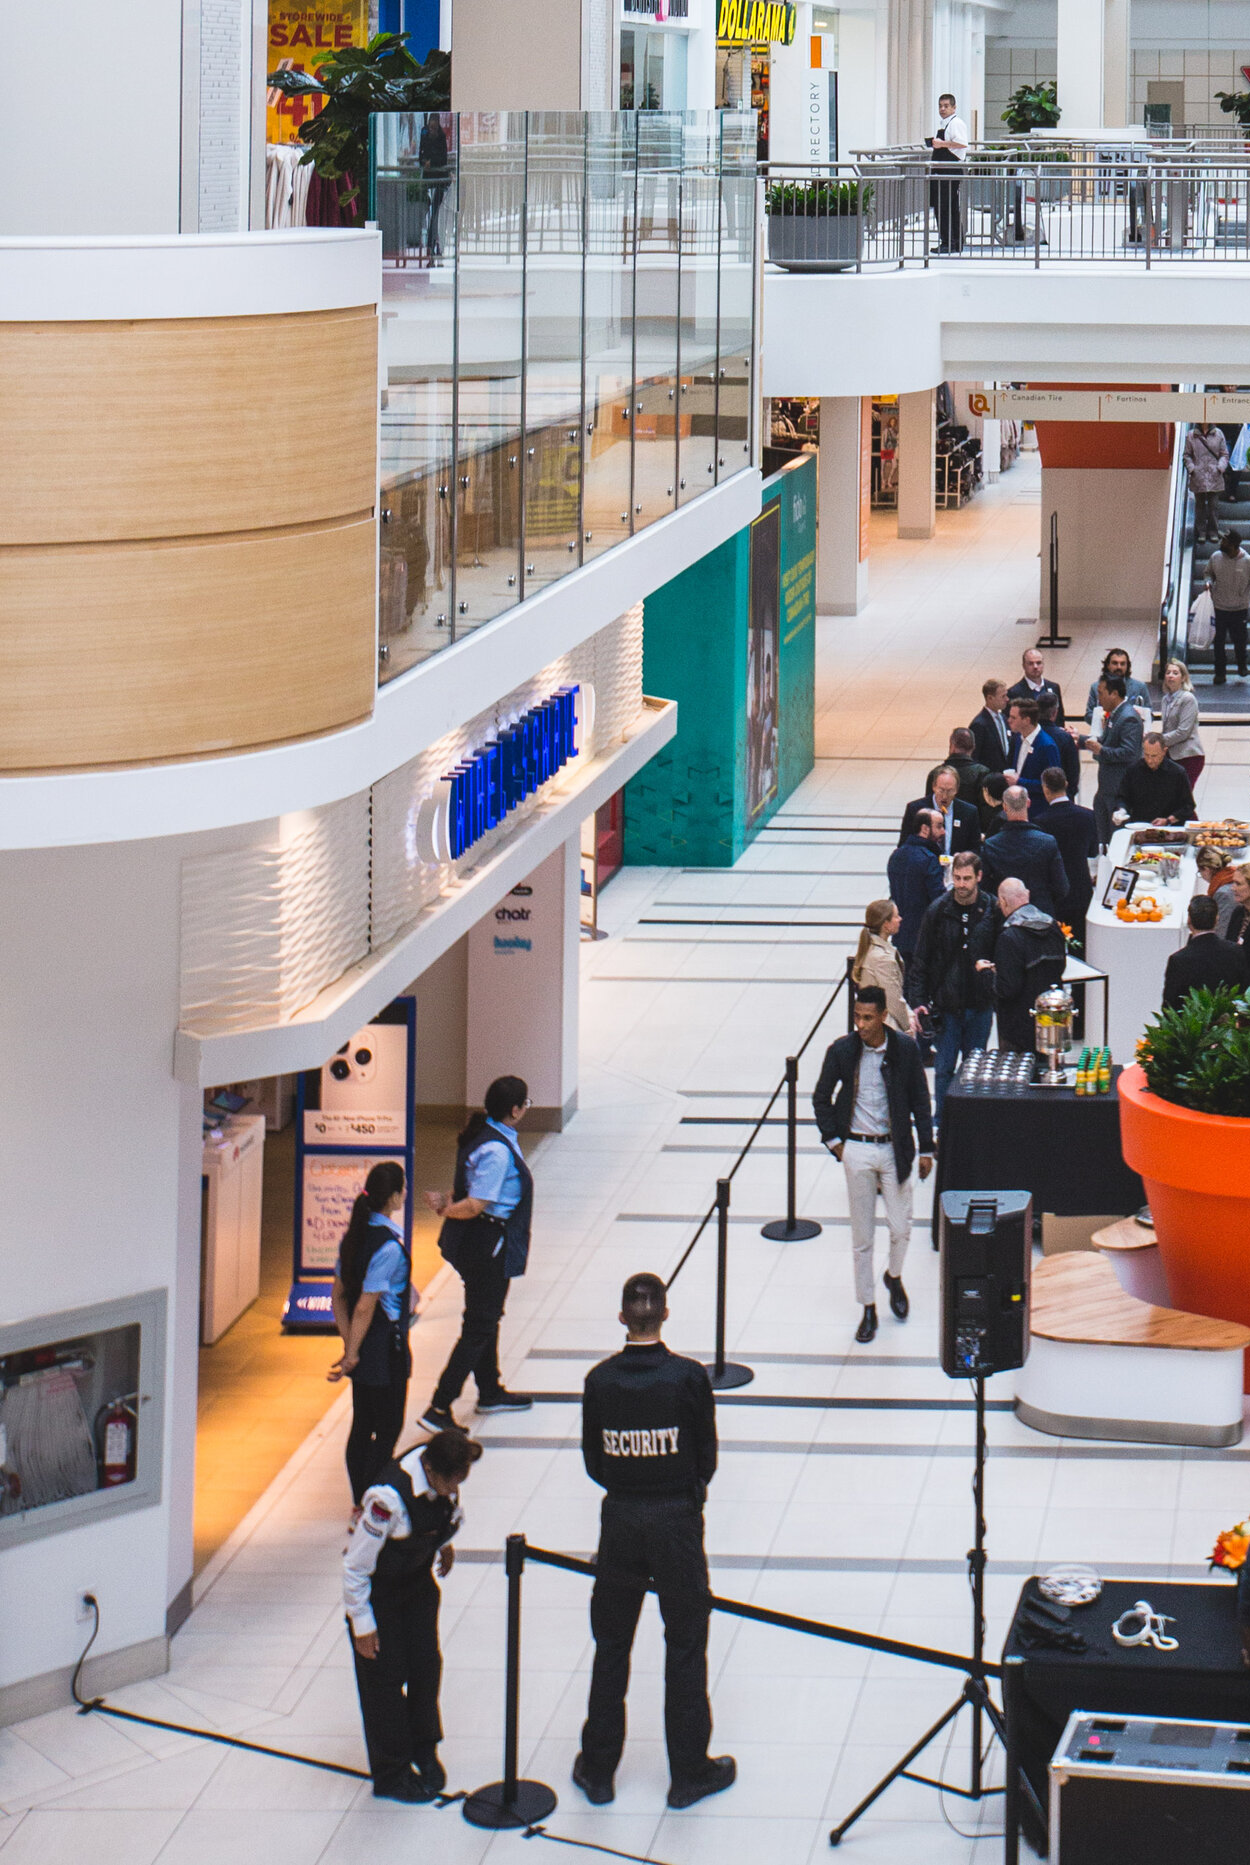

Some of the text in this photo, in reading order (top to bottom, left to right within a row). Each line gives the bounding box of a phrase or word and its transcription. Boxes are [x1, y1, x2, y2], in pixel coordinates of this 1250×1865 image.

[279, 12, 344, 22] STOREWIDE
[269, 23, 354, 49] SALE
[1011, 394, 1046, 402] Canadian
[1048, 394, 1063, 402] Tire
[1116, 395, 1147, 403] Fortinos
[603, 1427, 679, 1457] SECURITY
